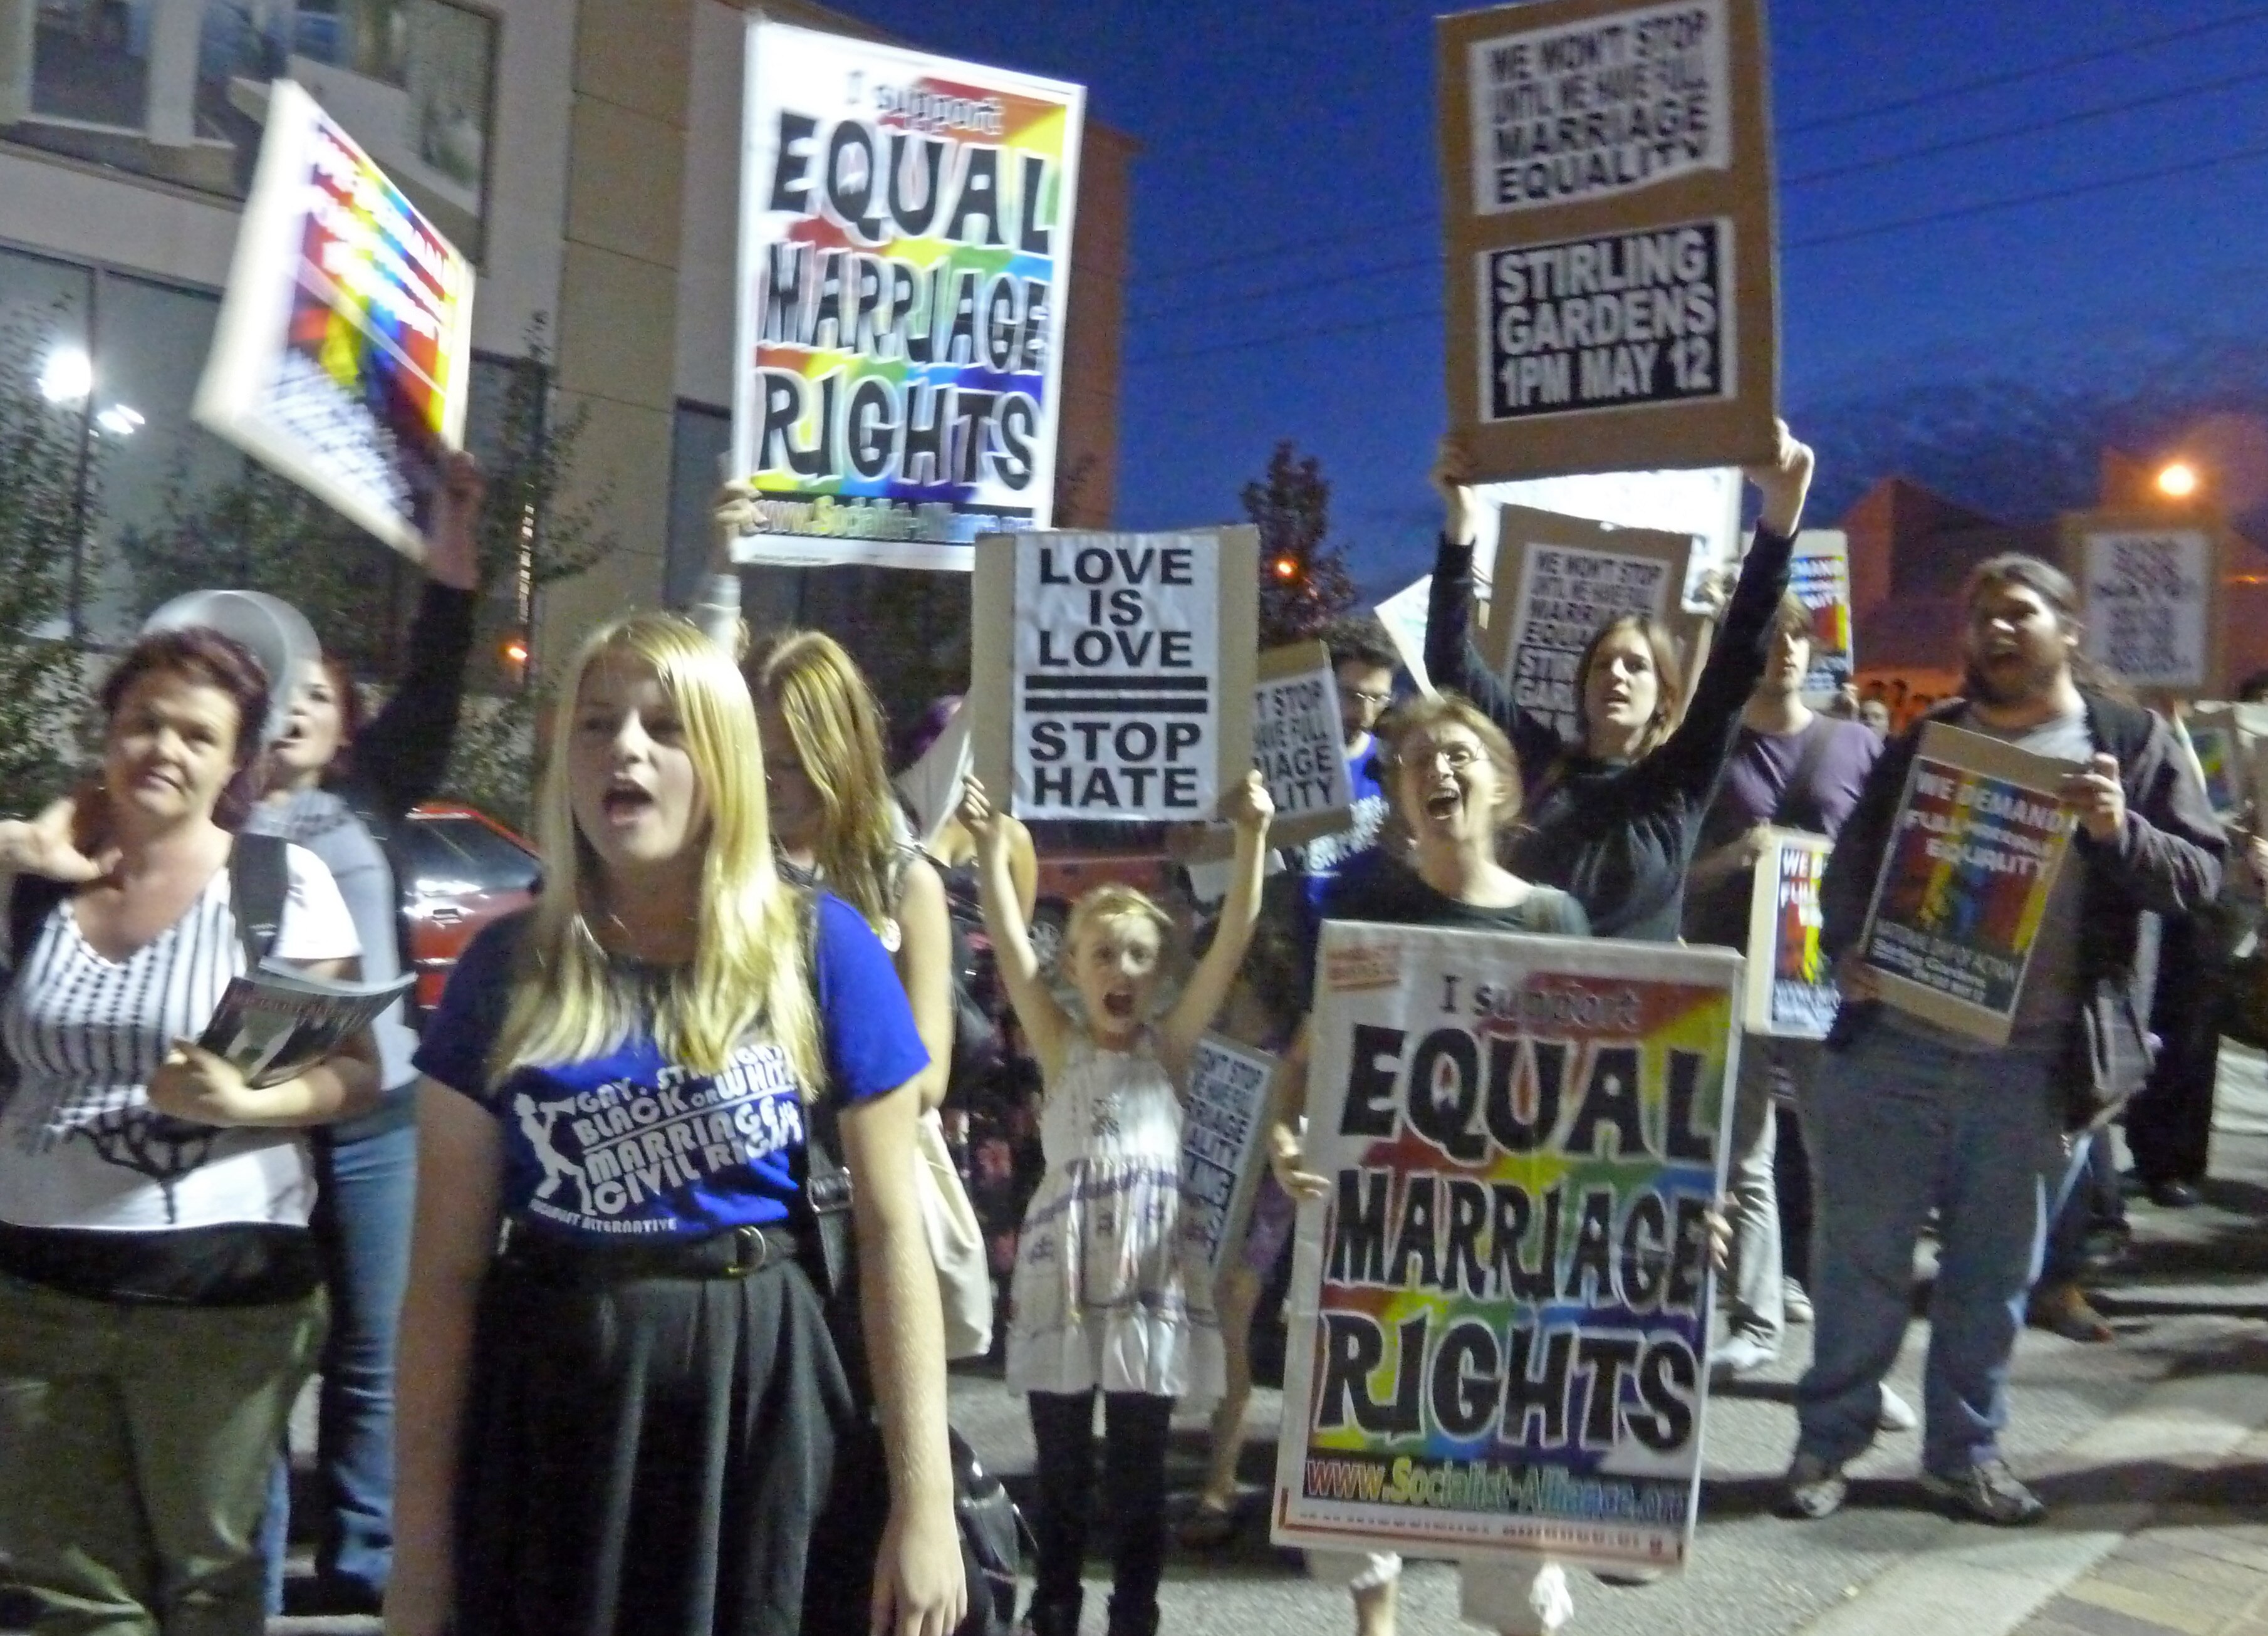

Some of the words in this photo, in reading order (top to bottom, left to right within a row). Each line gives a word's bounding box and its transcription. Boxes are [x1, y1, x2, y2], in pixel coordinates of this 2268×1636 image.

[771, 112, 1050, 256] EQUAL
[1494, 138, 1709, 204] EQUALITY
[1496, 229, 1707, 303] STIRLING
[762, 242, 1049, 375] MARRIAGE
[1496, 283, 1717, 356] GARDENS
[1500, 353, 1571, 407] 1PM
[1580, 342, 1658, 399] MAY
[1667, 335, 1712, 390] 12
[759, 375, 1036, 491] RIGHTS
[1039, 548, 1194, 585] LOVE
[1089, 588, 1143, 627] IS
[1038, 629, 1194, 668] LOVE
[1030, 722, 1200, 762] STOP
[1034, 768, 1198, 807] HATE
[1271, 776, 1334, 812] LITY
[1916, 772, 1956, 802] WE
[1956, 783, 2065, 836] DEMAND
[1442, 975, 1459, 1013] I
[571, 1086, 689, 1147] BLACK
[690, 1088, 719, 1108] OR
[1339, 1023, 1712, 1167] EQUAL
[585, 1094, 777, 1184] MARRIAGE
[594, 1153, 700, 1214] CIVIL
[1326, 1169, 1710, 1310] MARRIAGE
[1317, 1315, 1695, 1451] RIGHTS
